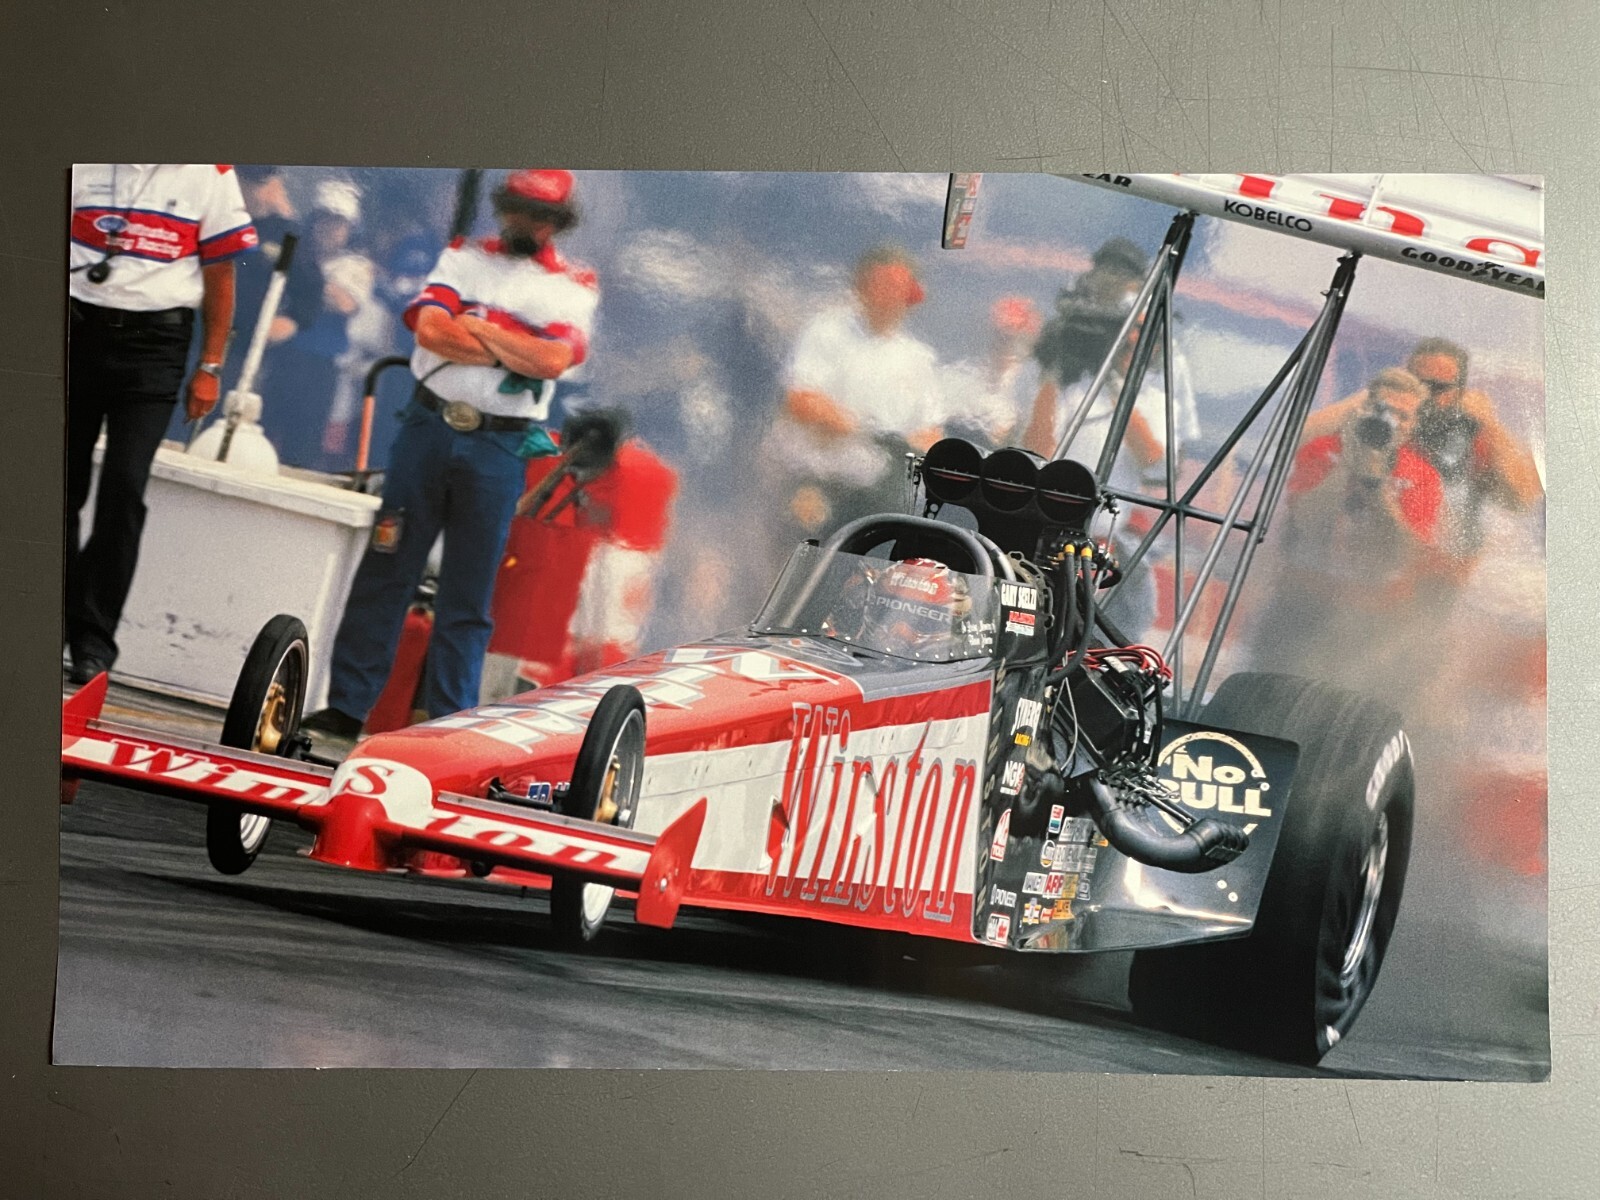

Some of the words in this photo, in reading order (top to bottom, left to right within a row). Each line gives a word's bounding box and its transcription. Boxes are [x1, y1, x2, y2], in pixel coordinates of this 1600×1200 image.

[1223, 199, 1313, 232] KOBELCO
[876, 596, 952, 622] PIONEER
[1001, 760, 1025, 789] NGK
[1171, 752, 1247, 785] No
[765, 701, 977, 922] Winston
